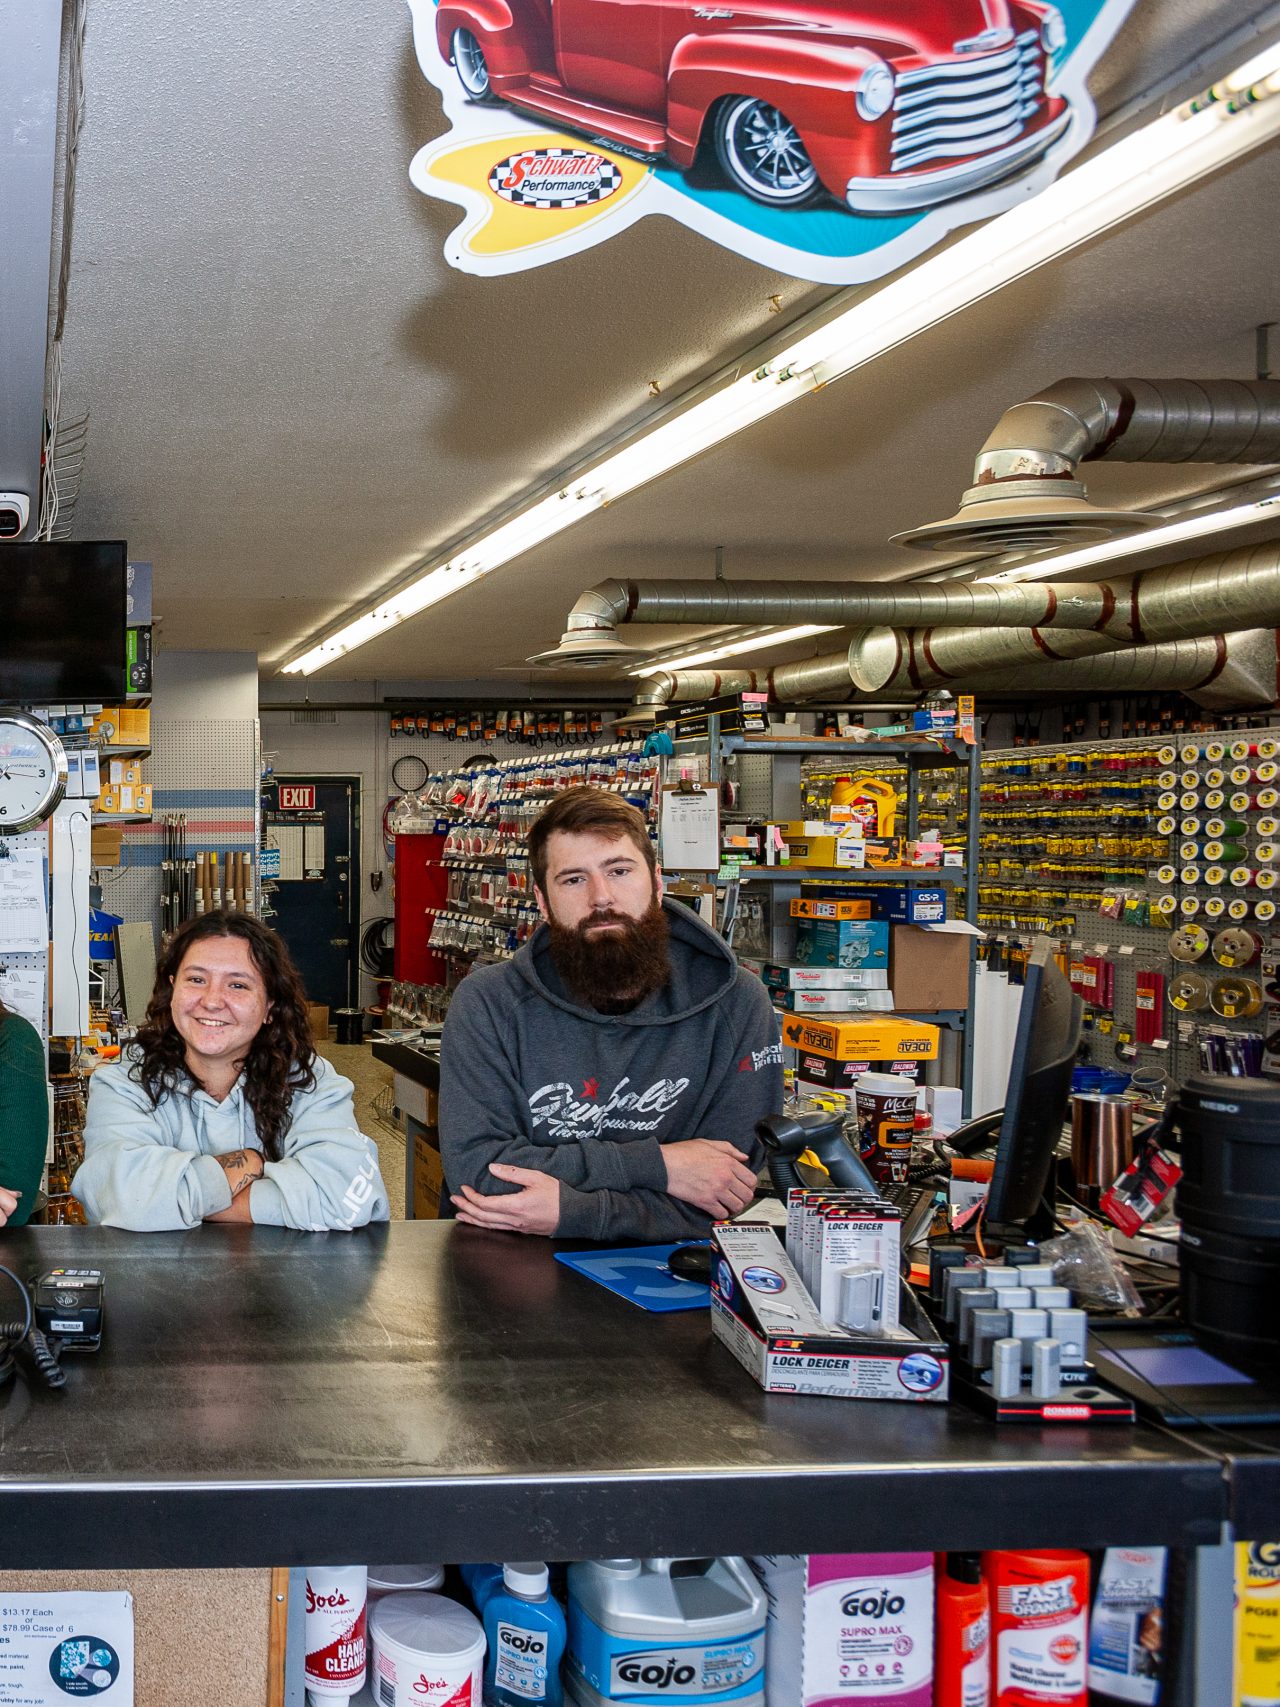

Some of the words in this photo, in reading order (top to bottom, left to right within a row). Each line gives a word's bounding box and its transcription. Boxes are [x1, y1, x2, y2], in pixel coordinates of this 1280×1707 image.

[502, 156, 605, 189] Schwartz
[521, 179, 596, 192] Performance
[38, 769, 46, 778] 3
[282, 788, 311, 807] EXIT
[0, 806, 7, 815] 6
[805, 1031, 833, 1051] IDEAL
[898, 1042, 932, 1053] IDEAL
[805, 1058, 825, 1069] BALDWIN
[1200, 1100, 1239, 1113] NEBO
[827, 1222, 850, 1231] LOCK
[852, 1222, 884, 1231] DEICER
[772, 1356, 807, 1367] LOCK
[807, 1358, 850, 1370] DEICER
[799, 1383, 904, 1399] Performance
[1043, 1406, 1089, 1416] RONSON
[1105, 1577, 1154, 1590] FAST
[1011, 1577, 1075, 1604] FAST
[306, 1586, 350, 1614] Joe's
[841, 1591, 905, 1619] GOJO
[2, 1608, 30, 1616] $13.17
[1012, 1599, 1077, 1617] ORANGE
[2, 1624, 30, 1632] $78.99
[841, 1627, 876, 1637] SUPRO
[879, 1626, 903, 1635] MAX
[338, 1638, 364, 1659] HAND
[500, 1630, 544, 1654] GOJO
[522, 1656, 539, 1664] MAX
[618, 1658, 696, 1689] GOJO
[413, 1673, 449, 1694] Joe's
